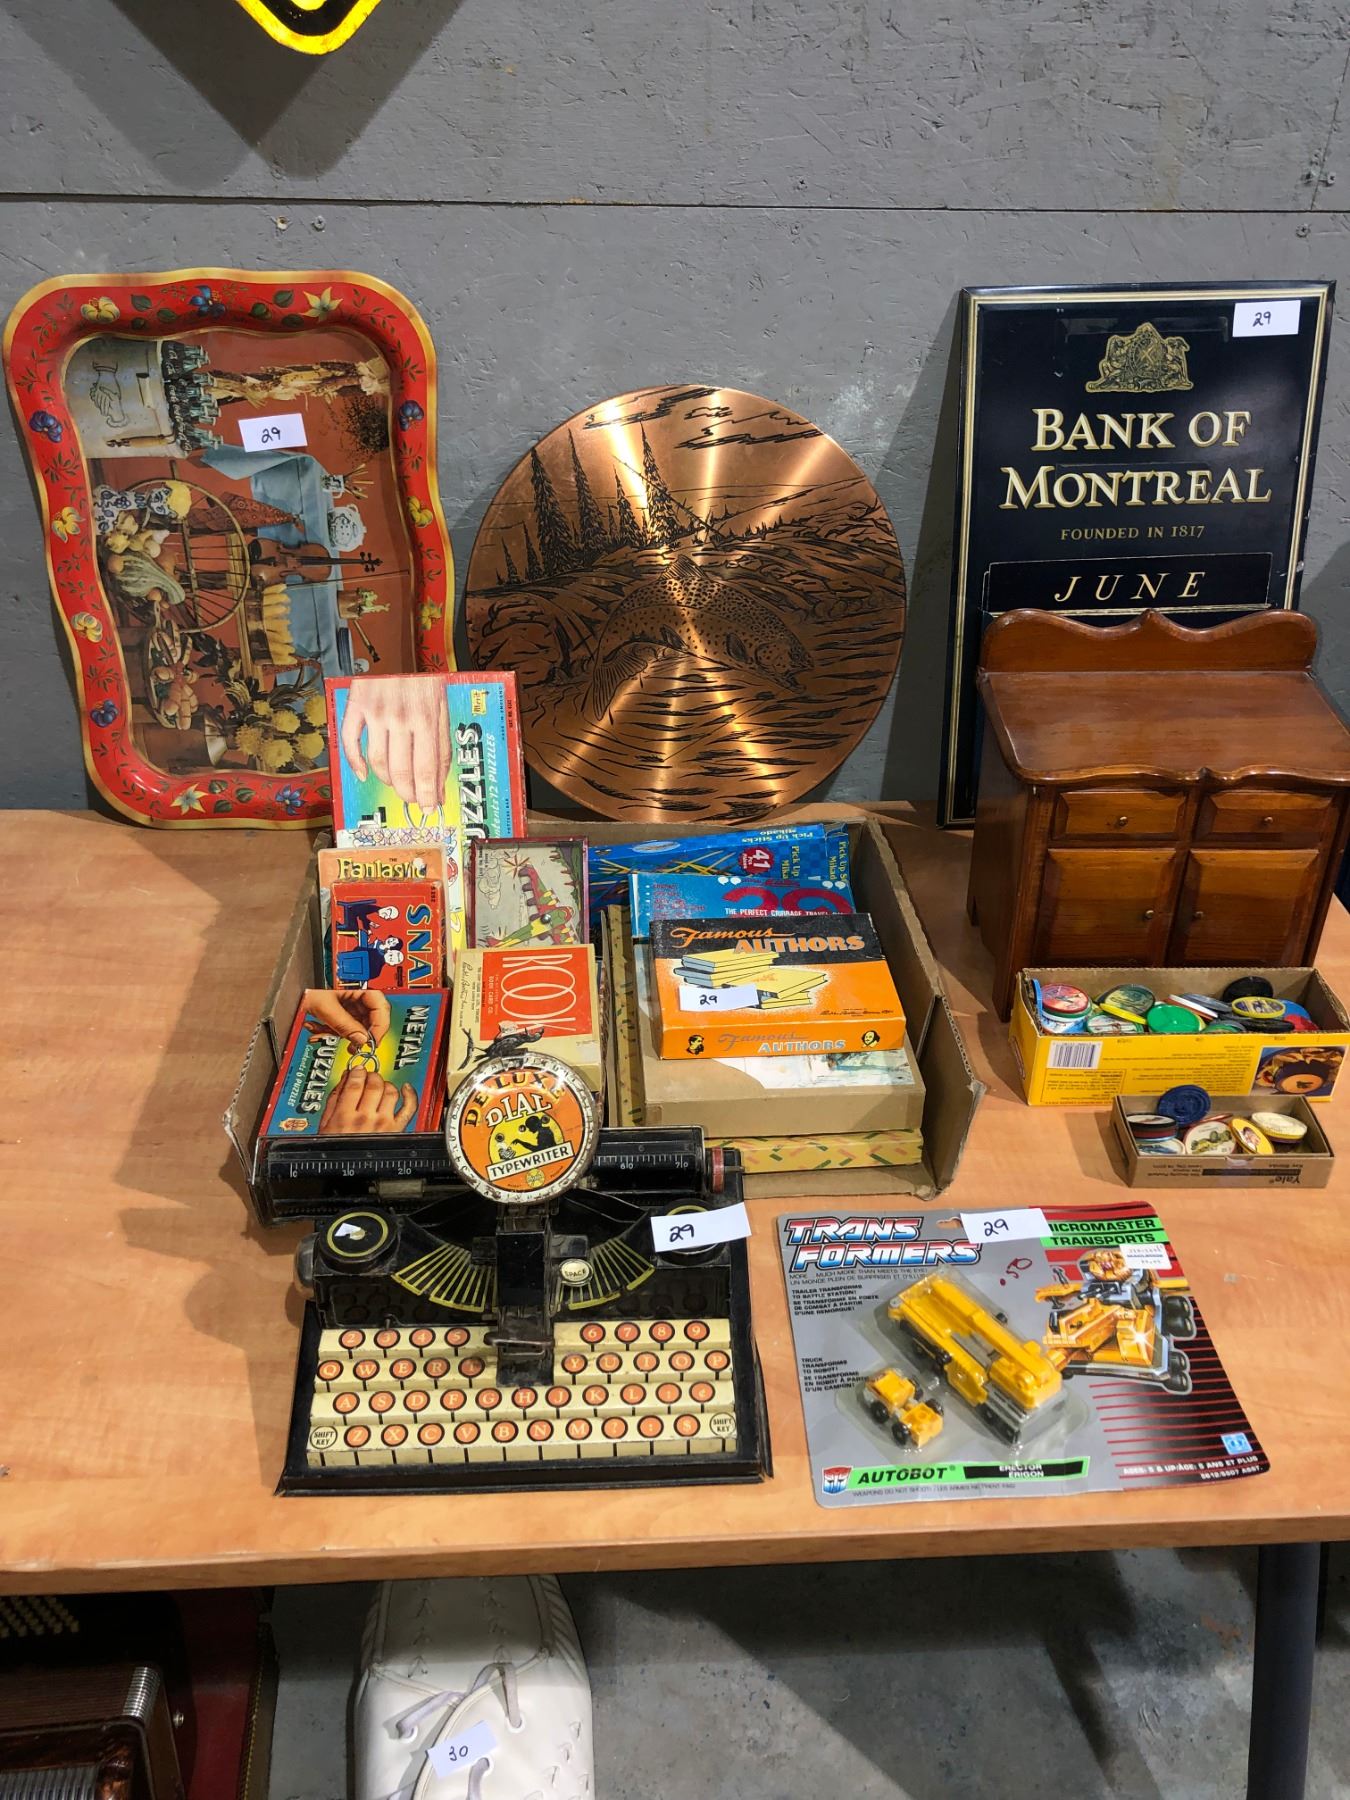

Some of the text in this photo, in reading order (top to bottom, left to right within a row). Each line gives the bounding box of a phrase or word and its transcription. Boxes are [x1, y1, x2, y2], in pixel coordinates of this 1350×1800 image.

[1252, 311, 1271, 327] 29
[260, 426, 282, 444] 29
[1031, 407, 1252, 451] BANK OF
[999, 465, 1272, 510] MONTREAL
[1060, 525, 1205, 541] FOUNDED IN 1817
[1054, 571, 1206, 602] JUNE
[486, 733, 497, 783] PUZZLES
[455, 722, 490, 848] UZZLES
[753, 849, 771, 869] 41
[791, 845, 800, 863] Pick
[839, 841, 847, 859] Pick
[782, 860, 790, 879] Mika
[829, 856, 838, 879] Mikad
[725, 907, 737, 915] THE
[740, 908, 767, 916] PERFECT
[670, 926, 795, 948] Famous
[735, 935, 866, 954] AUTHORS
[501, 953, 577, 1031] ROOK
[699, 993, 718, 1006] 29
[396, 1005, 431, 1069] METAL
[718, 1032, 809, 1051] Famous
[757, 1039, 846, 1053] AUTHORS
[298, 1044, 314, 1071] Contents
[299, 1035, 341, 1113] PUZZLES
[287, 1078, 302, 1106] PUZZLES
[485, 1091, 553, 1128] DIAL
[343, 1167, 355, 1177] 10
[398, 1166, 412, 1176] 20
[488, 1146, 570, 1179] TYPEWRITER
[620, 1160, 634, 1170] 60
[669, 1223, 695, 1243] 29
[786, 1217, 922, 1244] TRANS
[983, 1218, 1009, 1236] 29
[1048, 1219, 1155, 1233] ICROMASTER
[1050, 1233, 1155, 1246] TRANSPORTS
[790, 1239, 983, 1272] FORMERS
[563, 1268, 587, 1279] SPACE
[347, 1333, 355, 1343] 2
[418, 1332, 426, 1343] 4
[453, 1332, 461, 1342] 5
[588, 1327, 597, 1338] 6
[623, 1327, 632, 1338] 7
[658, 1326, 666, 1337] 8
[692, 1326, 700, 1336] 9
[324, 1364, 337, 1376] Q
[357, 1363, 374, 1375] W
[399, 1362, 408, 1374] E
[432, 1361, 443, 1373] R
[569, 1357, 580, 1368] Y
[604, 1357, 616, 1368] U
[675, 1355, 688, 1367] O
[712, 1355, 723, 1366] P
[339, 1397, 352, 1408] A
[378, 1396, 386, 1407] S
[412, 1395, 423, 1406] D
[449, 1394, 459, 1405] F
[482, 1393, 495, 1404] G
[519, 1392, 531, 1403] H
[555, 1391, 563, 1402] J
[590, 1390, 602, 1401] K
[629, 1389, 639, 1400] L
[713, 1418, 732, 1426] SHIFT
[717, 1425, 731, 1433] KEY
[314, 1430, 334, 1439] SHIFT
[315, 1438, 330, 1446] KEY
[352, 1430, 362, 1442] Z
[388, 1429, 400, 1441] X
[424, 1428, 436, 1440] C
[460, 1428, 474, 1439] V
[499, 1426, 510, 1438] B
[534, 1424, 547, 1436] N
[571, 1423, 586, 1434] M
[857, 1466, 947, 1484] AUTOBOT
[998, 1463, 1043, 1473] ERECTOR
[448, 1745, 469, 1762] 30
